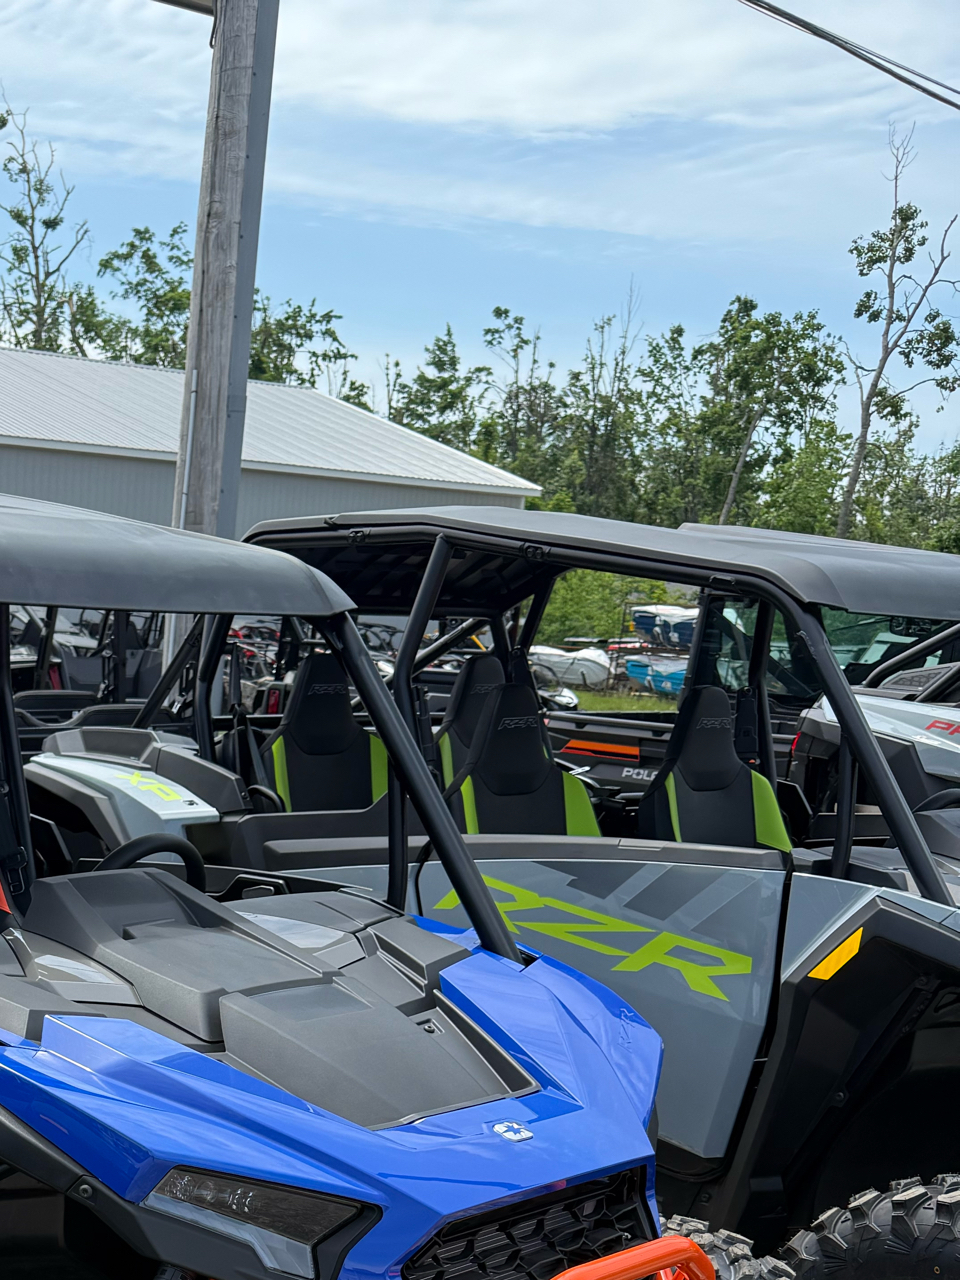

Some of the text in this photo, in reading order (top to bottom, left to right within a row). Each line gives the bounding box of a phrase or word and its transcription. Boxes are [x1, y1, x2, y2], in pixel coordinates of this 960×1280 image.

[498, 715, 538, 730] RZR
[696, 717, 730, 729] RZR
[114, 771, 182, 802] XP
[433, 874, 753, 1001] RZR
